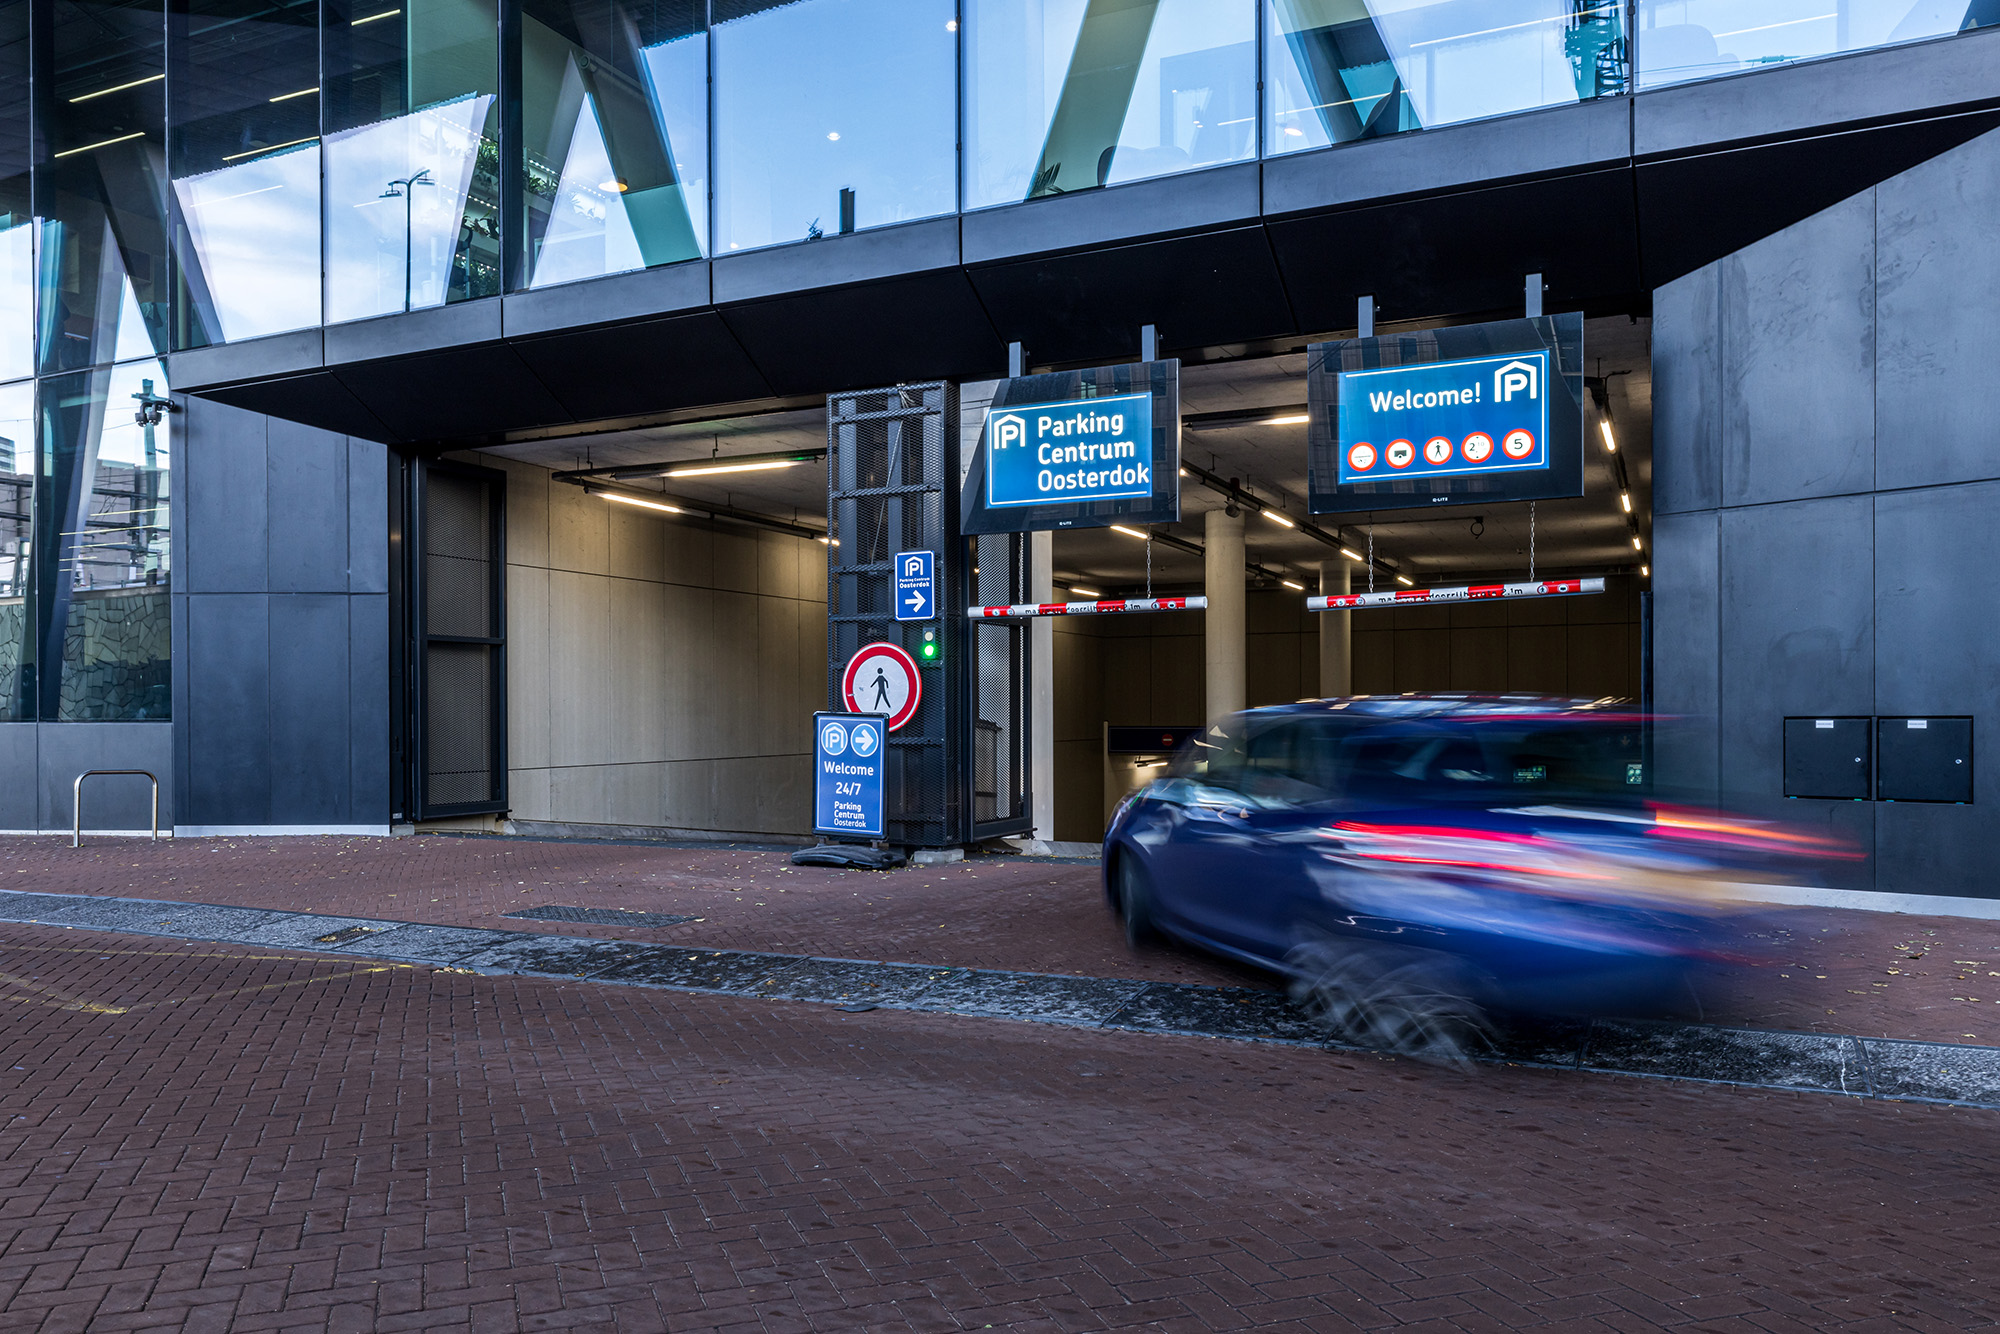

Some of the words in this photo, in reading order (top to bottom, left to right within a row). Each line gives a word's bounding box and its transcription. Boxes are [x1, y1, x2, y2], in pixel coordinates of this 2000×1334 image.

[1370, 382, 1481, 413] Welcome!
[1038, 411, 1124, 438] Parking
[1514, 438, 1523, 450] 5
[1038, 440, 1135, 466] Centrum
[1038, 462, 1150, 492] Oosterdok
[899, 581, 930, 589] Oosterdok
[824, 761, 874, 776] Welcome
[836, 782, 862, 796] 24/7
[834, 801, 862, 812] Parking
[834, 810, 865, 820] Centrum
[834, 818, 867, 828] Oosterdok
